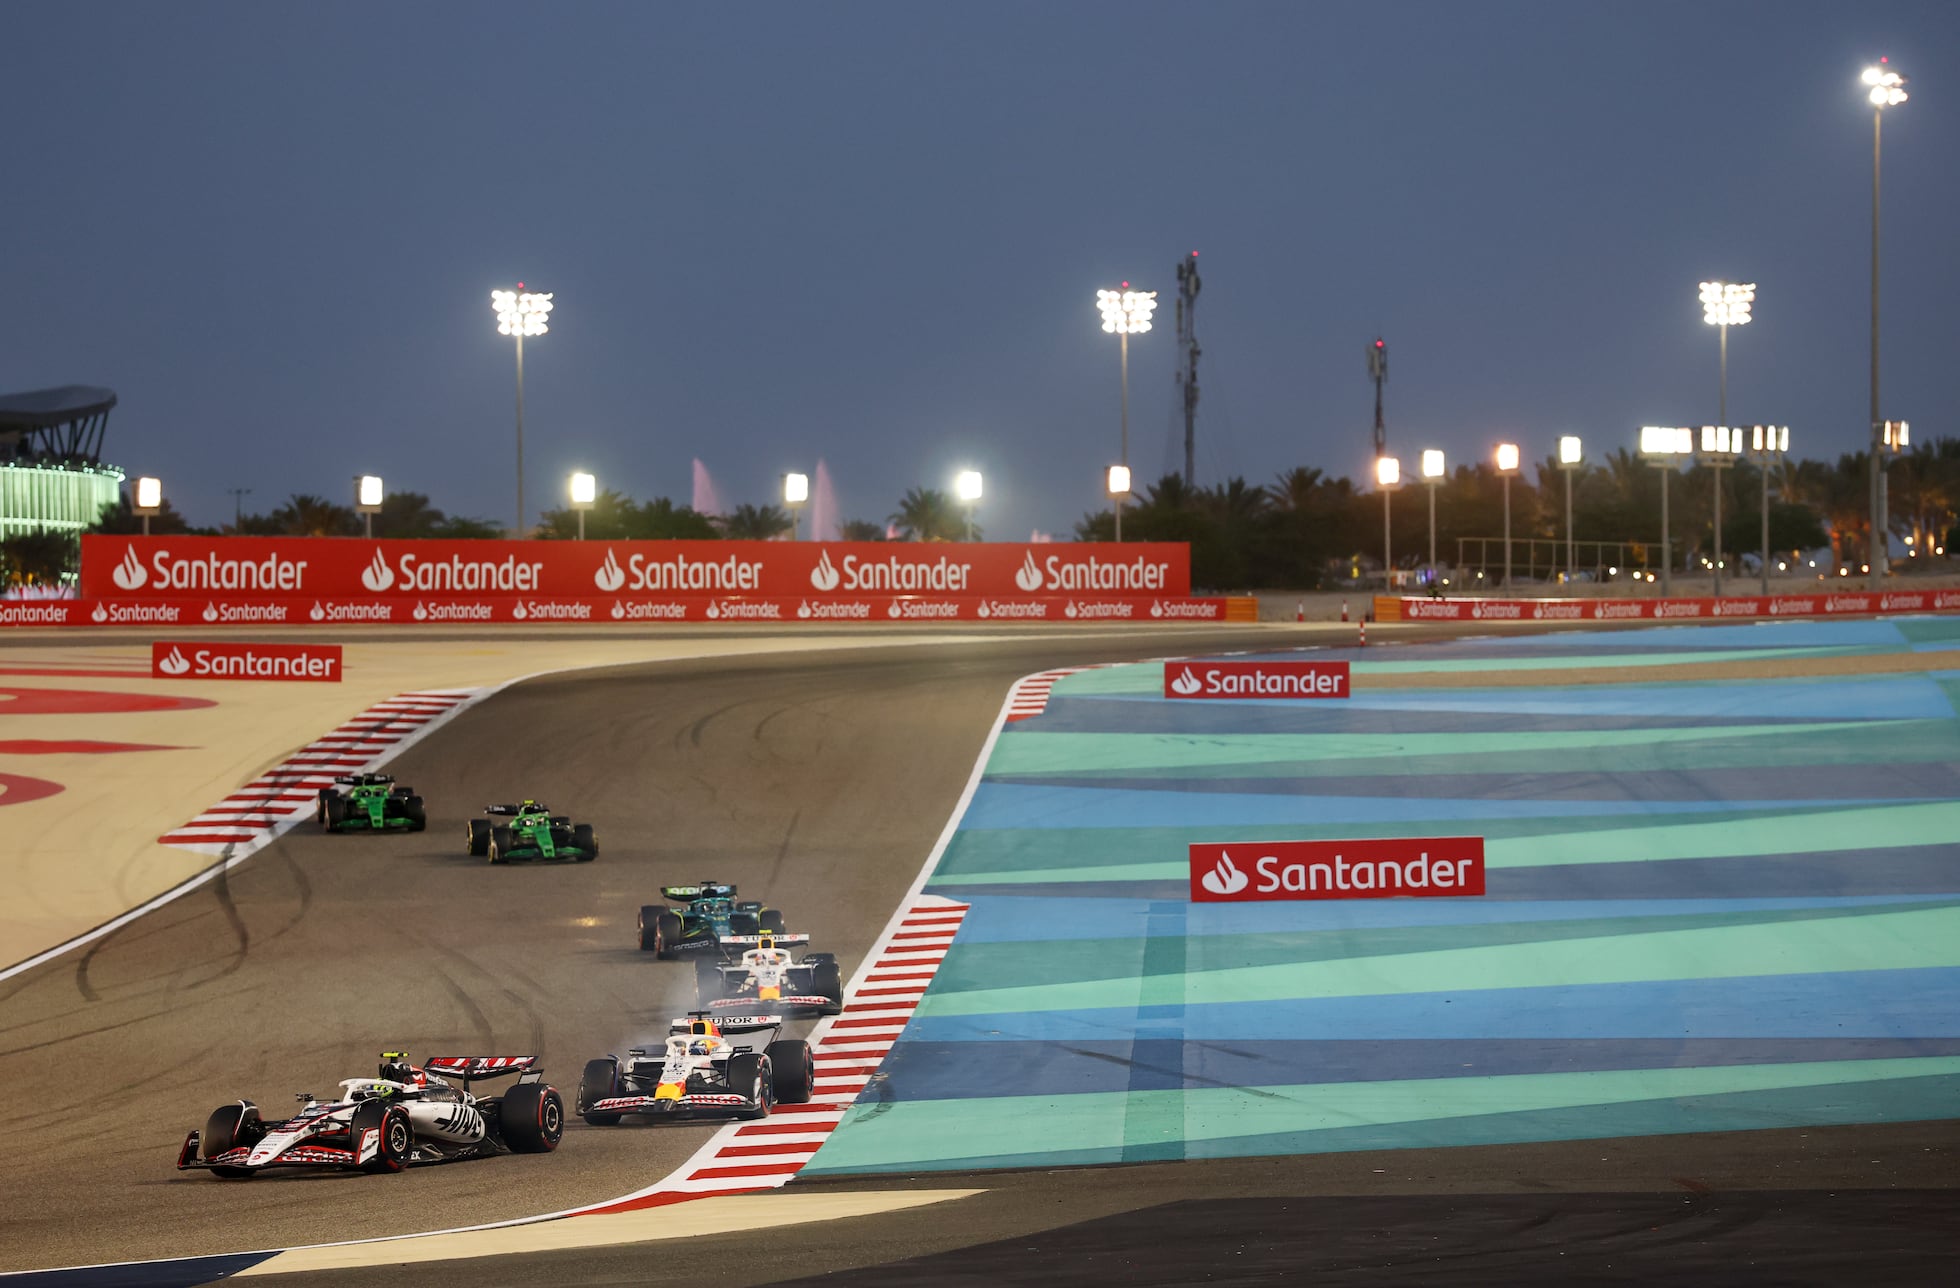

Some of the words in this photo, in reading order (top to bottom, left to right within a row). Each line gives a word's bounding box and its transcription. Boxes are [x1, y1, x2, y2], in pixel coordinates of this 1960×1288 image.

[153, 551, 307, 590] Santander
[400, 554, 543, 591] Santander
[630, 554, 763, 591] Santander
[844, 555, 971, 591] Santander
[1046, 556, 1169, 590] Santander
[626, 602, 687, 618] Santander
[721, 602, 780, 618] Santander
[812, 602, 871, 618] Santander
[902, 602, 960, 618] Santander
[990, 601, 1047, 617] Santander
[1078, 602, 1133, 617] Santander
[1162, 602, 1218, 617] Santander
[1418, 602, 1459, 617] Santander
[1481, 602, 1521, 618] Santander
[1603, 602, 1642, 617] Santander
[1662, 601, 1701, 616] Santander
[1721, 600, 1757, 615] Santander
[1778, 599, 1814, 613] Santander
[1834, 596, 1869, 611] Santander
[1888, 595, 1924, 609] Santander
[109, 603, 180, 622] Santander
[219, 603, 287, 621] Santander
[326, 603, 392, 620] Santander
[428, 602, 492, 619] Santander
[528, 602, 592, 619] Santander
[1543, 603, 1582, 618] Santander
[195, 651, 335, 677] Santander
[1206, 670, 1344, 693] Santander
[1256, 852, 1473, 893] Santander
[671, 886, 727, 895] arao
[709, 1016, 753, 1025] UDOR
[599, 1096, 644, 1109] HUGO
[690, 1095, 741, 1105] HUGO
